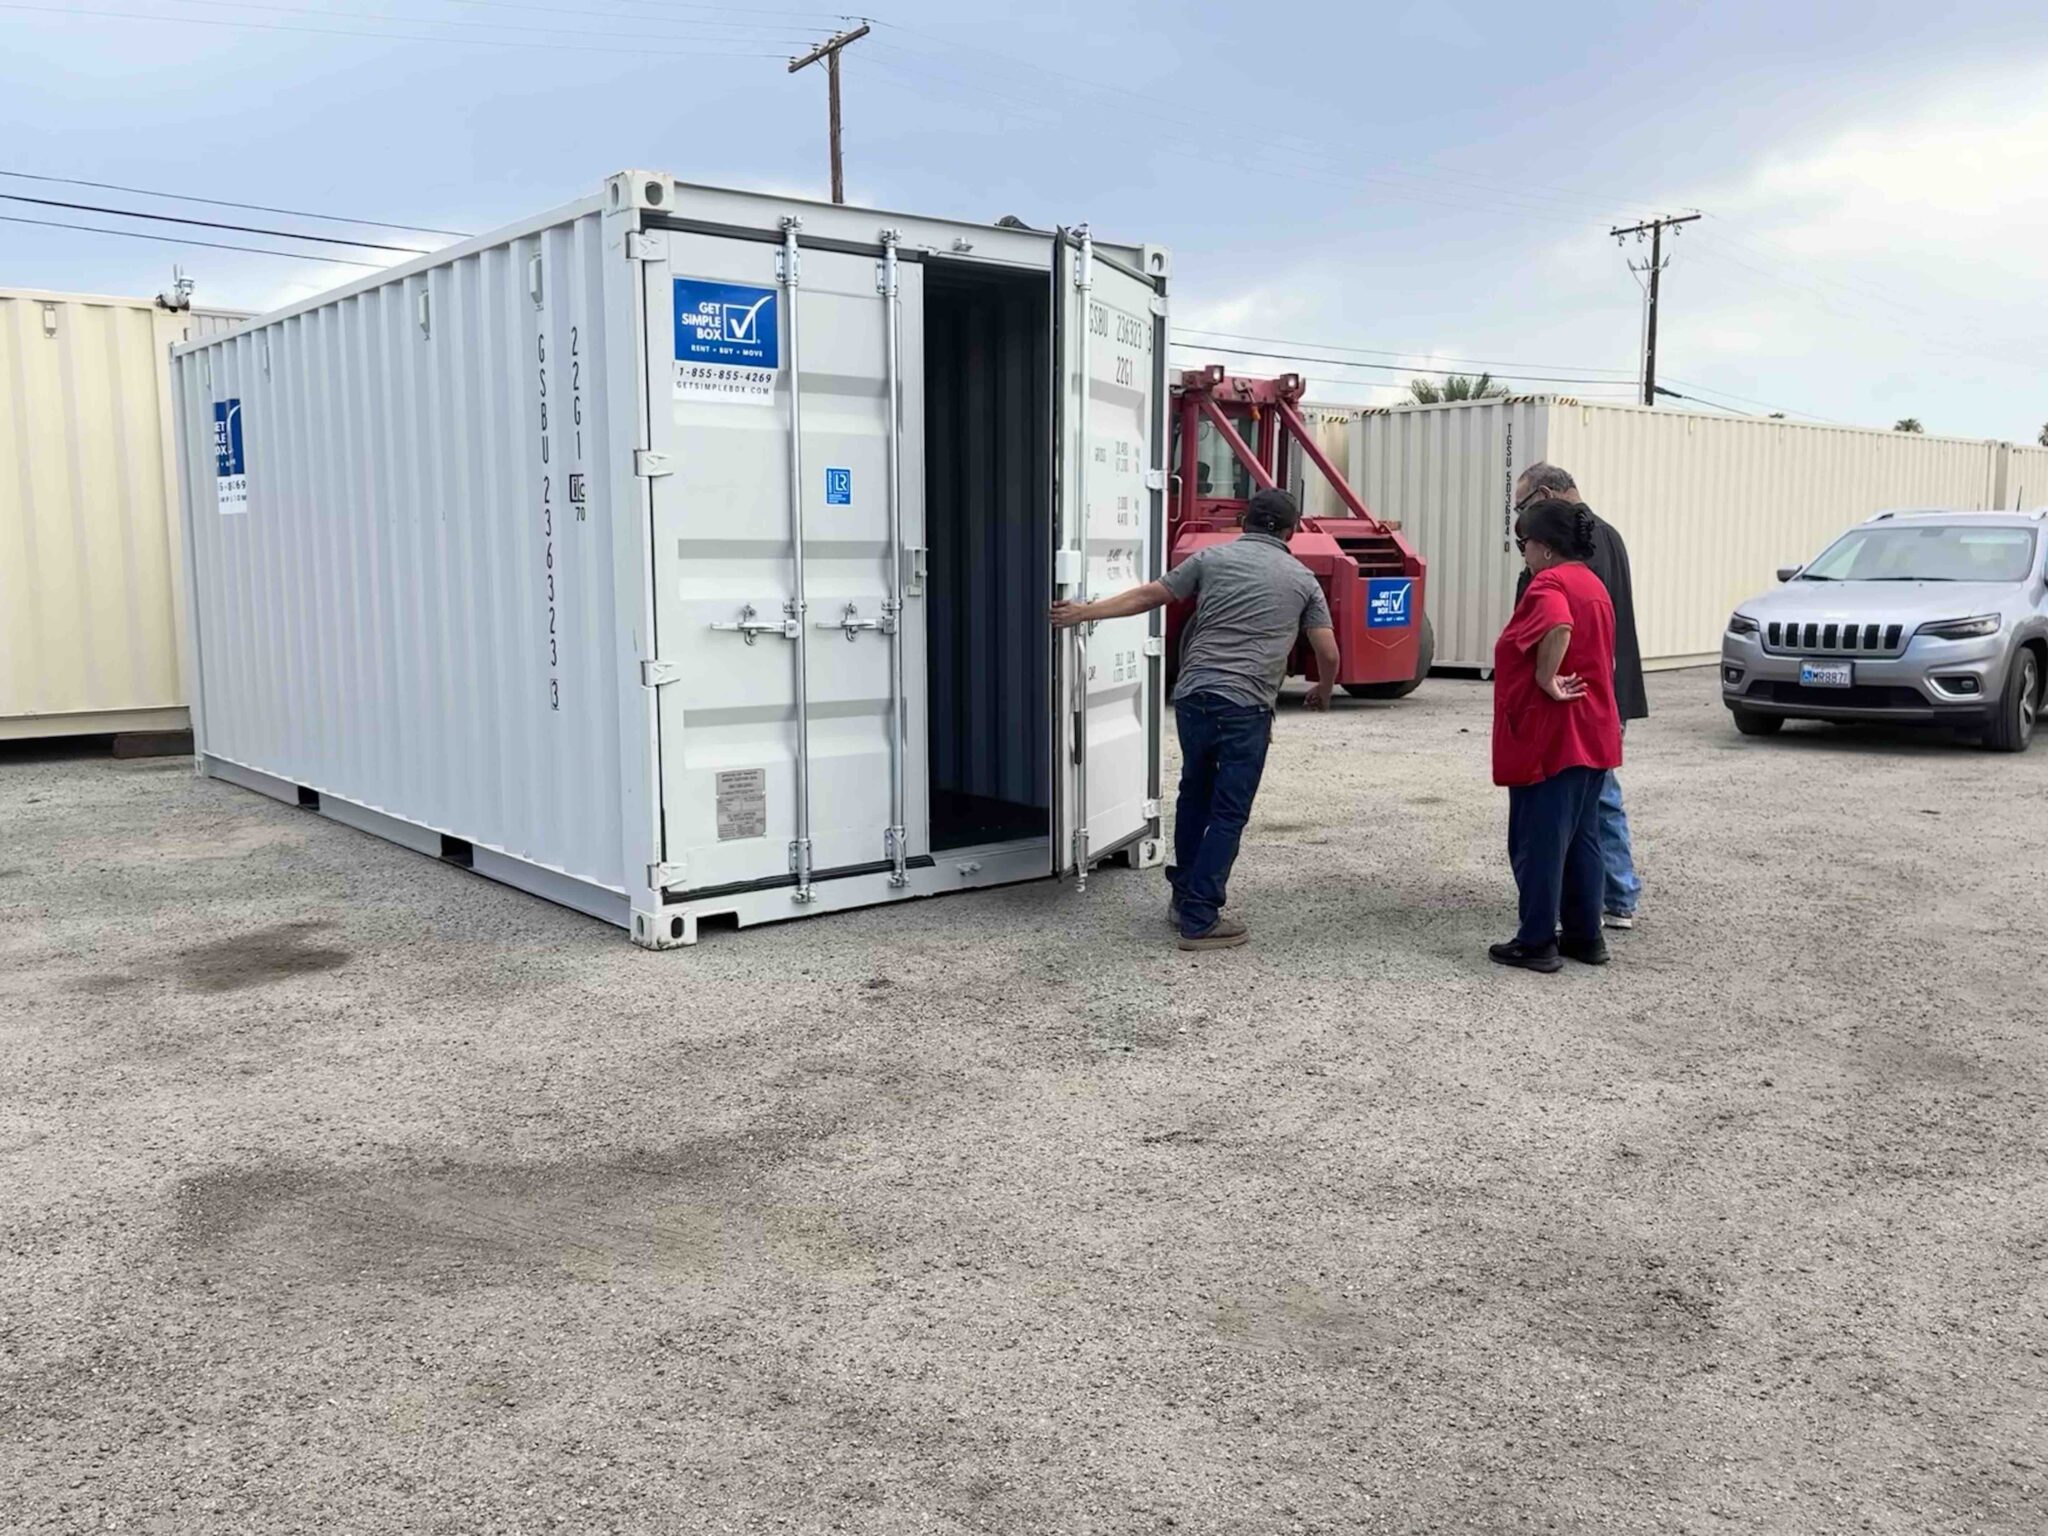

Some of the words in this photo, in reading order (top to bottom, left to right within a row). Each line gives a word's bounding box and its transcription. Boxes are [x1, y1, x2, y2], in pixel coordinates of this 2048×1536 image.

[699, 302, 721, 315] GET
[682, 313, 722, 328] SIMPLE
[697, 328, 722, 341] BOX
[1117, 314, 1142, 349] 236323
[691, 344, 710, 353] RENT
[719, 347, 733, 355] BUY
[742, 349, 763, 358] MOVE
[679, 367, 772, 383] 1-855-855-4269
[1116, 355, 1133, 387] 22G1
[676, 381, 769, 394] GETSIMPLEBOXCOM
[537, 334, 550, 464] GSBU
[836, 474, 847, 491] LR
[575, 506, 585, 521] 70
